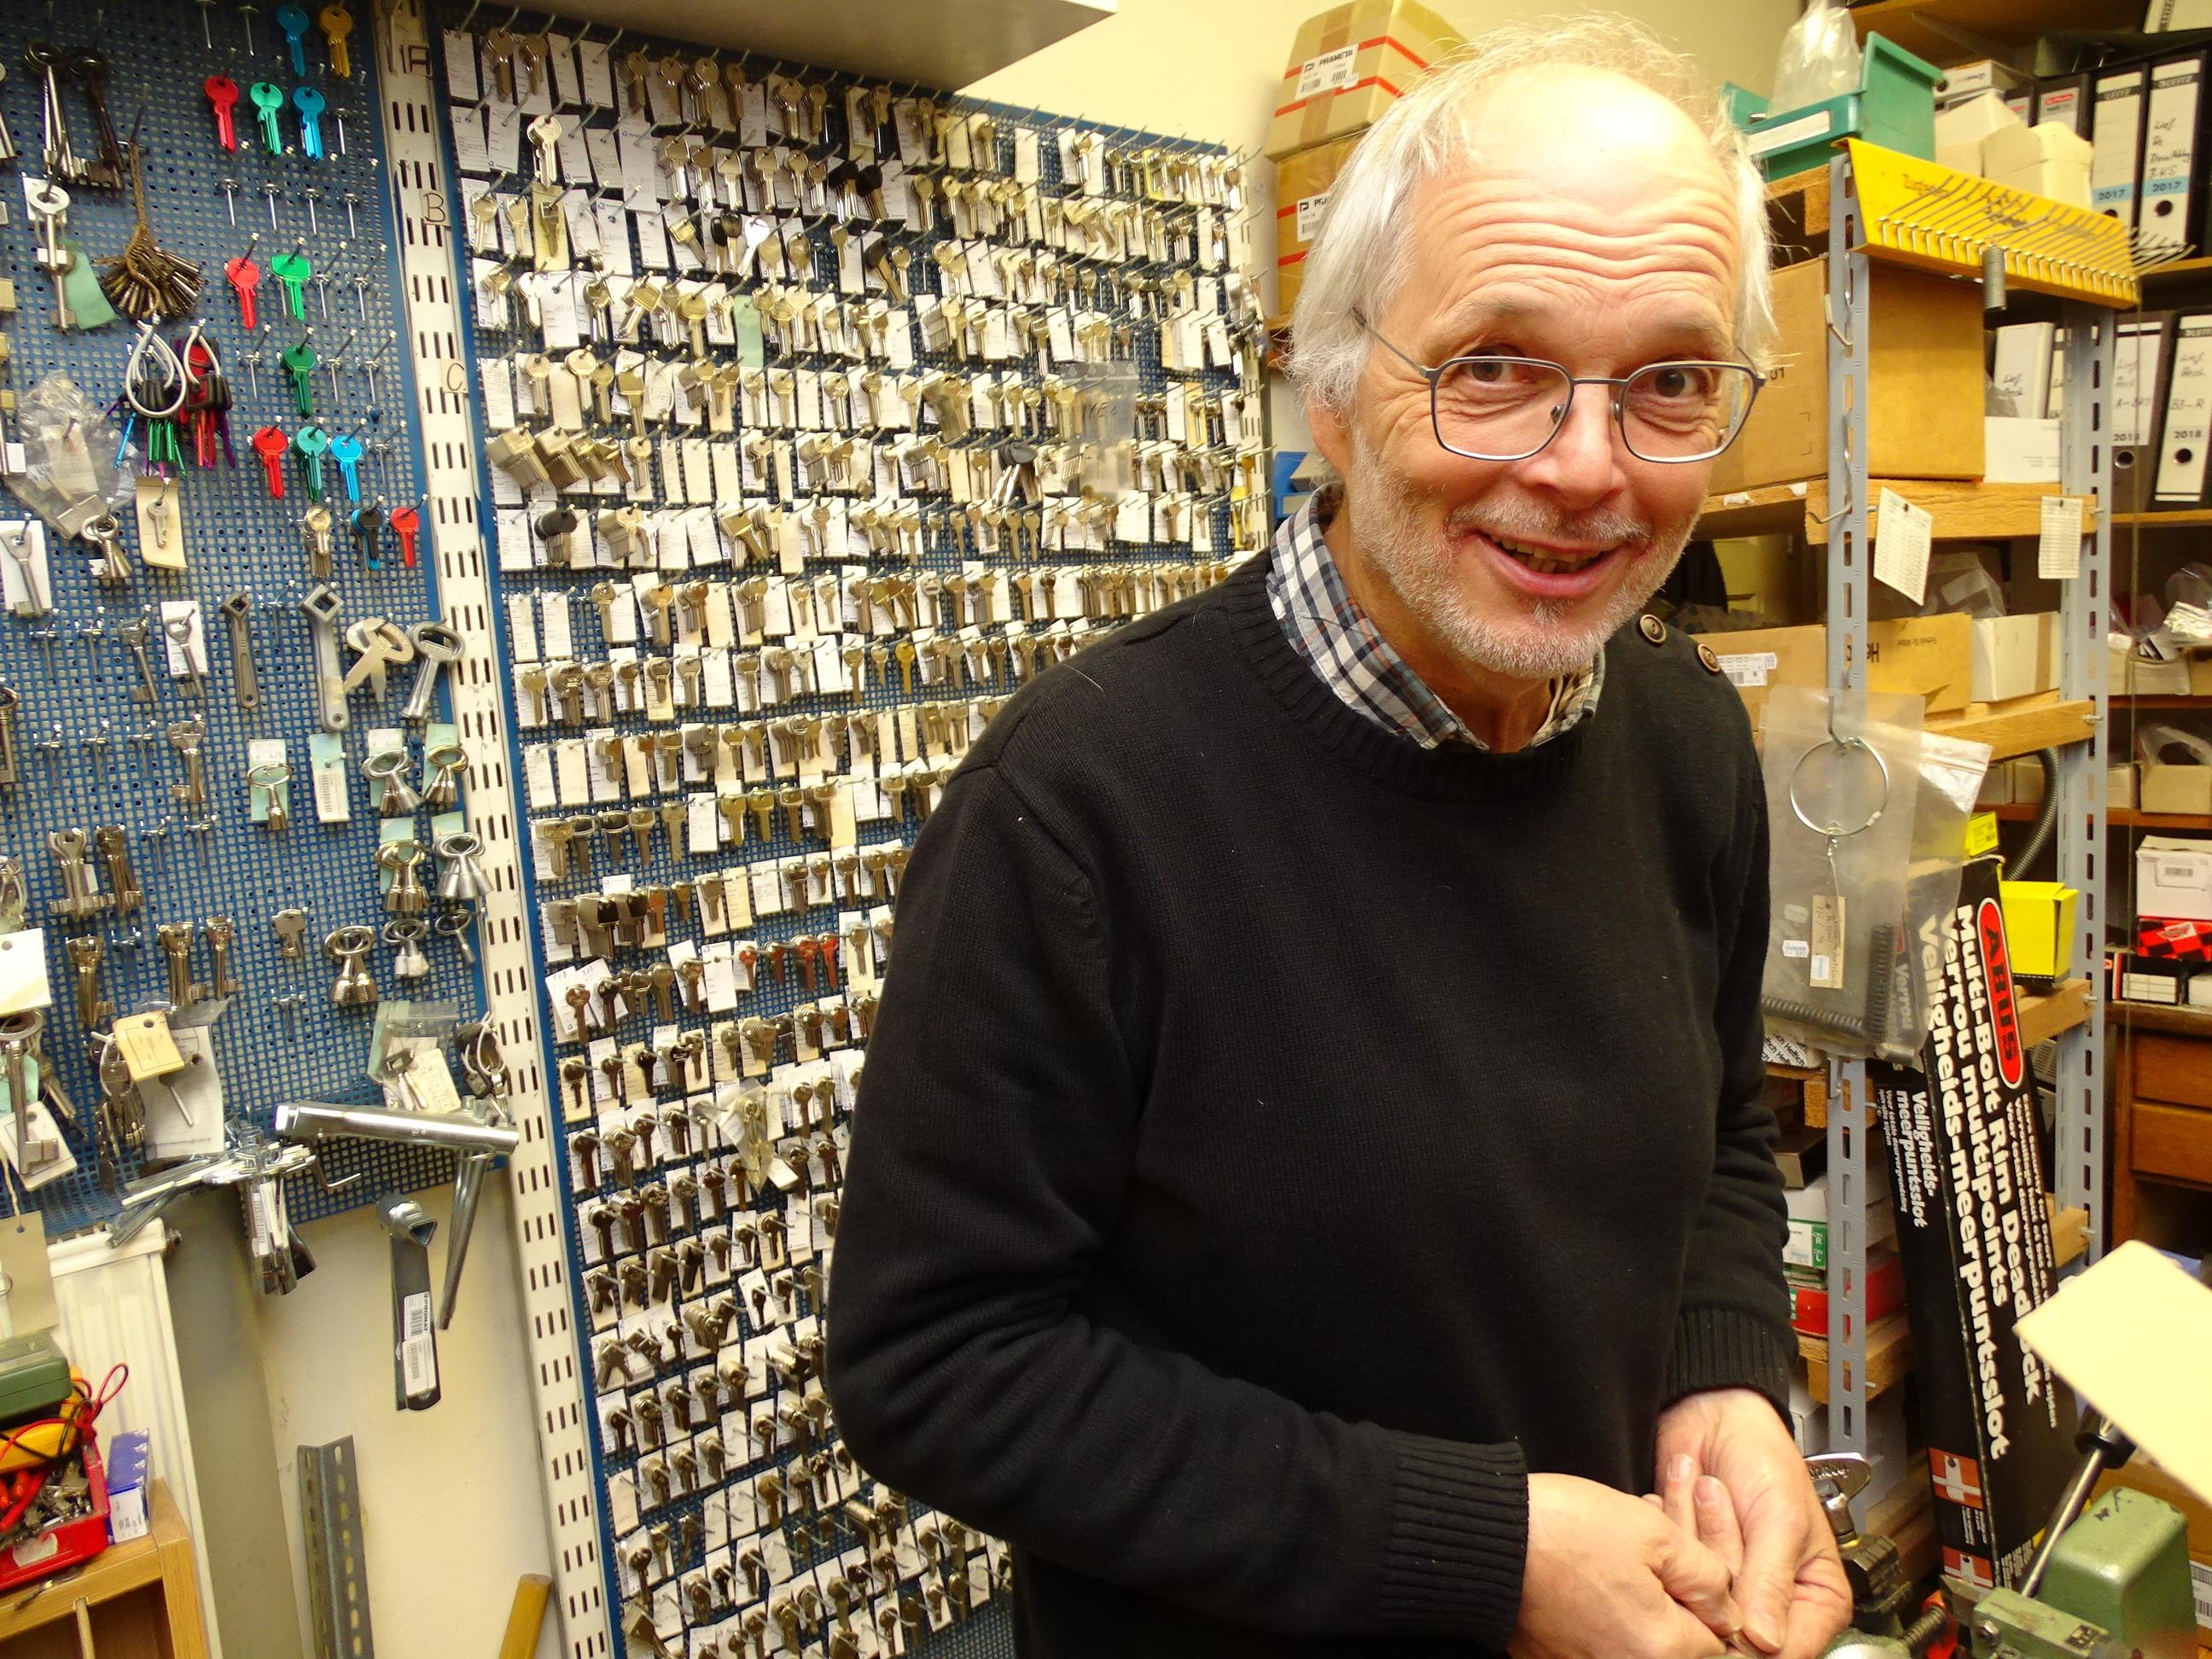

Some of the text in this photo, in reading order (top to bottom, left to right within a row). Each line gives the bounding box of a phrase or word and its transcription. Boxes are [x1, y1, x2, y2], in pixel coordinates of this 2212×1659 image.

[2097, 189, 2126, 201] 2017
[2152, 182, 2182, 193] 2017
[423, 193, 445, 224] B
[446, 364, 465, 392] C
[2174, 430, 2202, 439] 2018
[1985, 926, 2018, 1062] ABUS
[1941, 909, 2008, 1307] Verrou multipoints
[2006, 1102, 2017, 1139] Voor
[1896, 1090, 1929, 1228] meerpuntsslot
[1912, 1091, 1939, 1197] Veiligheids-
[1957, 905, 2041, 1406] Multi-Bolt Rim Deadock
[2015, 1097, 2033, 1186] Verrouillage
[2011, 1140, 2024, 1187] totale
[2028, 1135, 2042, 1195] Security
[2041, 1222, 2053, 1268] Doors
[2028, 1187, 2040, 1223] haut
[2036, 1243, 2046, 1268] bas
[2040, 1269, 2049, 1290] de
